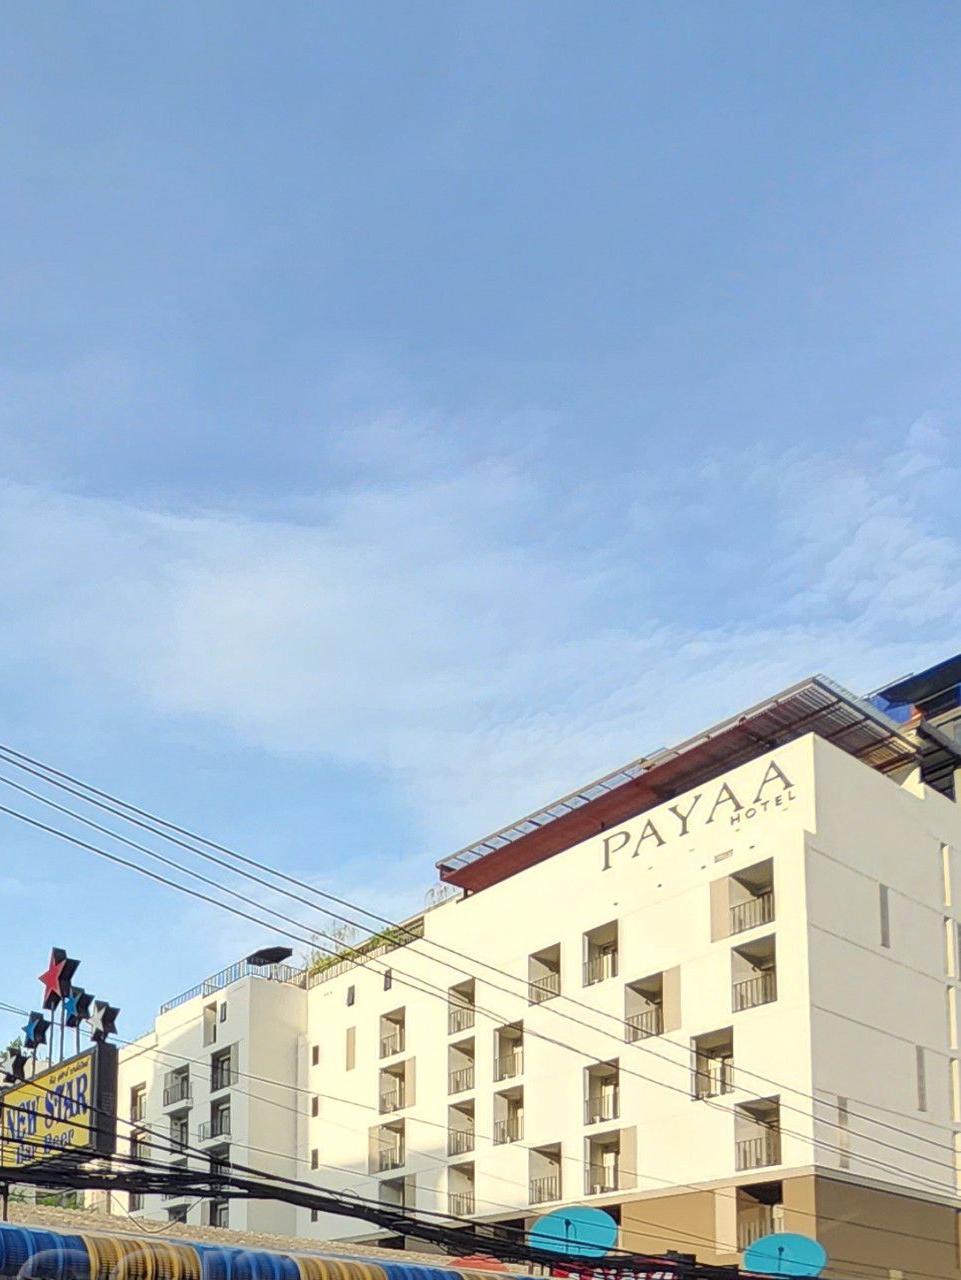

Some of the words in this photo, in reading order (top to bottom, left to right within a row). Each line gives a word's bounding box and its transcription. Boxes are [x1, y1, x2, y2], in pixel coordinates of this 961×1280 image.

[601, 760, 795, 872] PAYAA
[730, 791, 796, 826] HOTEL
[6, 1095, 40, 1141] NEW
[44, 1073, 88, 1129] STAR
